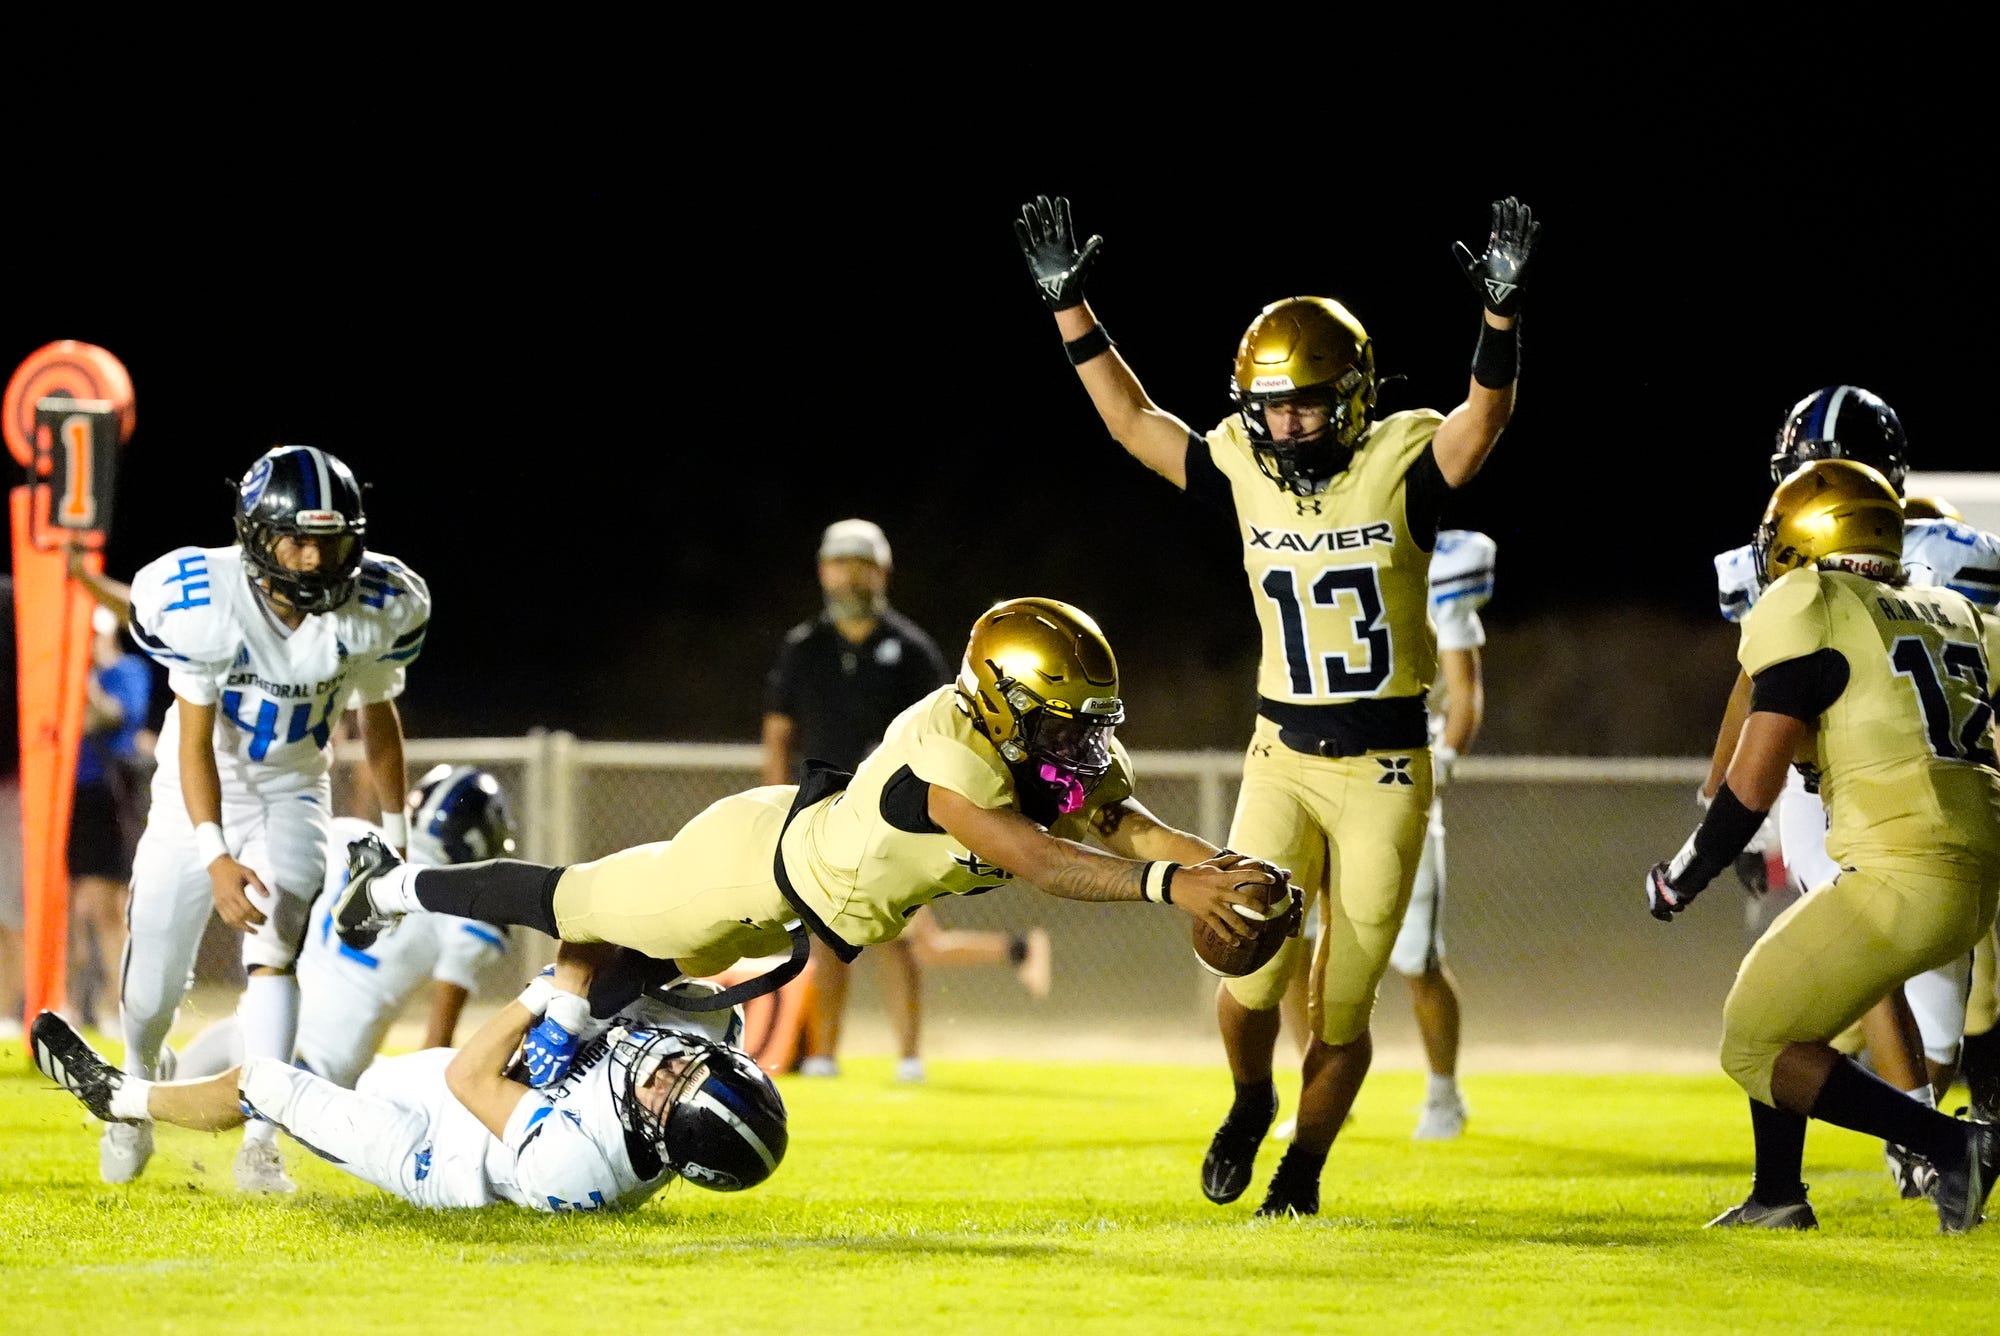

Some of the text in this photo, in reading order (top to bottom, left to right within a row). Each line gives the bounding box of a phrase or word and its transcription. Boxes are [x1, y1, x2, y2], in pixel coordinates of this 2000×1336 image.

[59, 415, 95, 527] 1
[1249, 521, 1394, 552] XAVIER
[162, 554, 211, 612] 44
[1261, 564, 1392, 697] 13
[226, 673, 310, 698] CATHEDRAL
[1889, 636, 1999, 771] 12
[221, 688, 341, 763] 44
